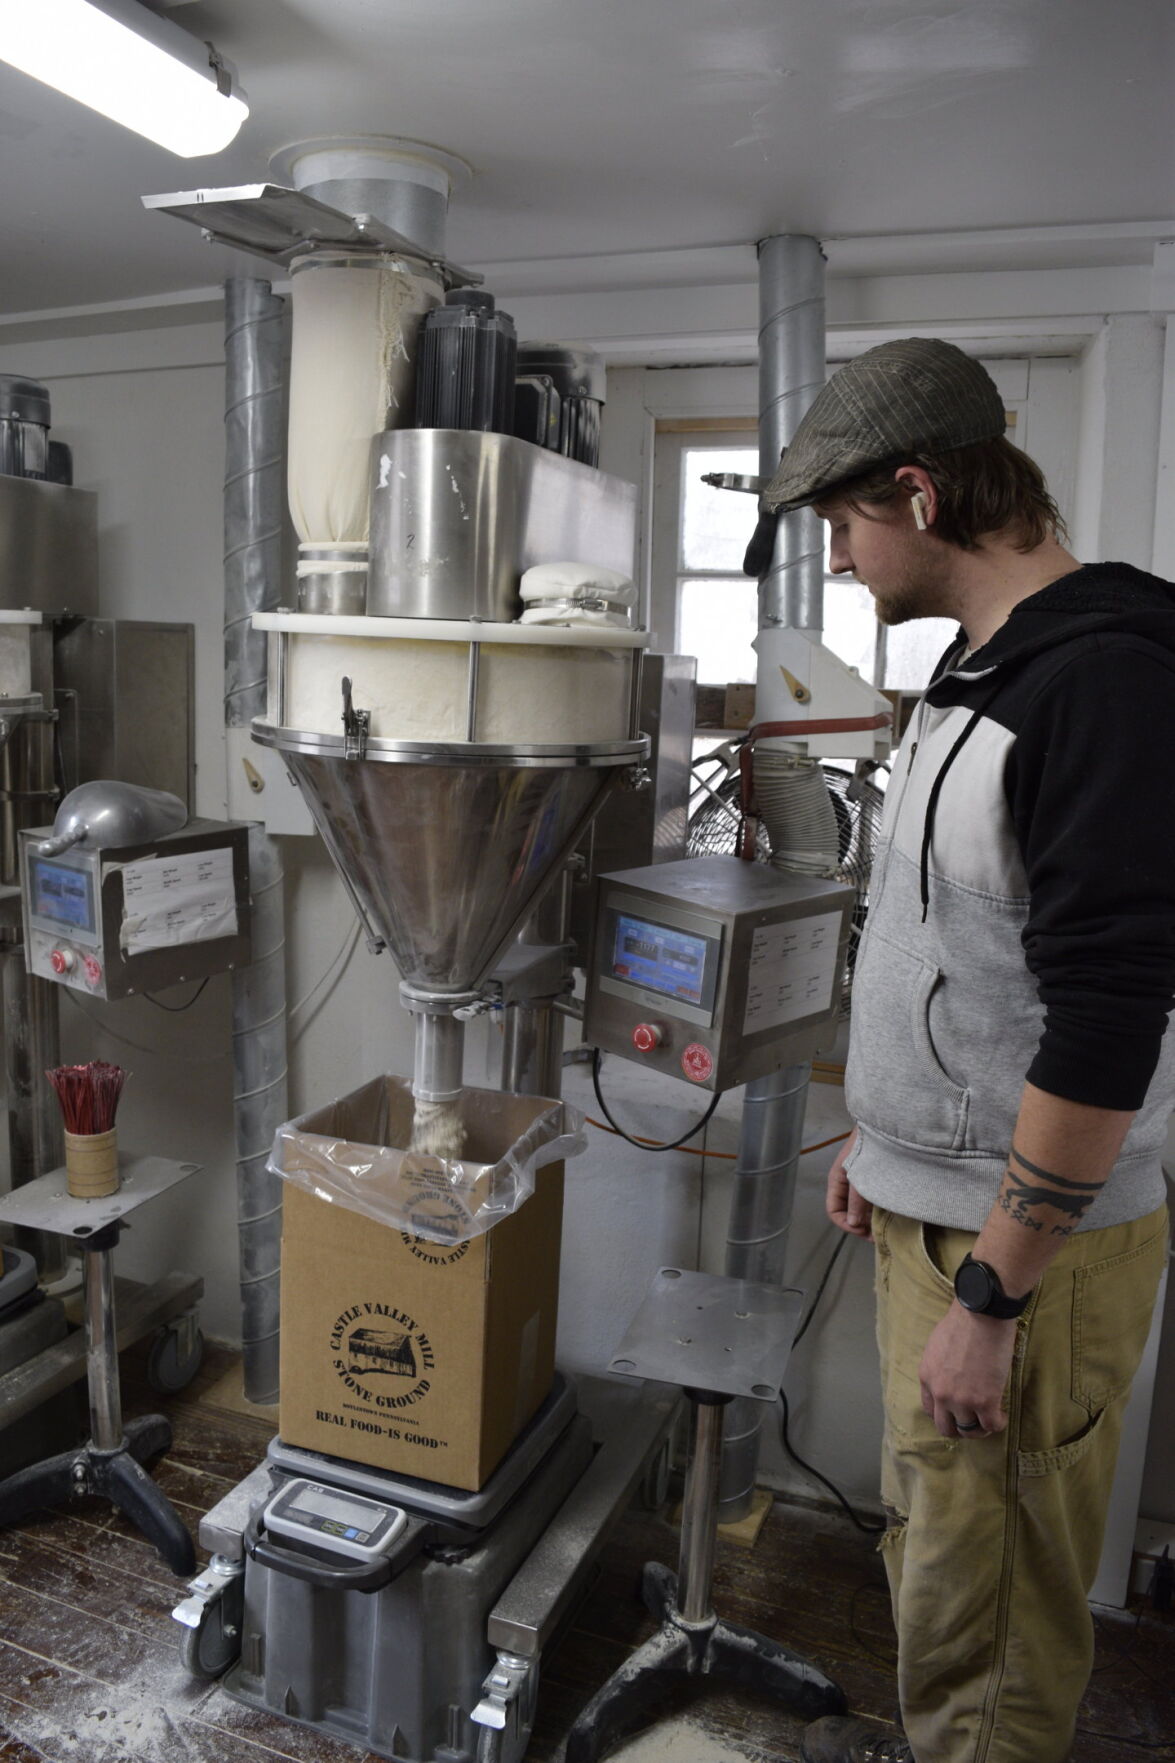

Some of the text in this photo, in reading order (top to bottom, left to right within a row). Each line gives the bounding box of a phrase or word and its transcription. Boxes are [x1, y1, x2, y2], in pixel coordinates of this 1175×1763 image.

[406, 534, 416, 550] 2
[410, 1245, 447, 1265] VALLEY
[330, 1302, 435, 1370] CASTLE VALLEY MILL
[333, 1359, 431, 1408] STONE GROUND
[315, 1410, 347, 1427] REAL
[350, 1418, 401, 1440] FOOD-IS
